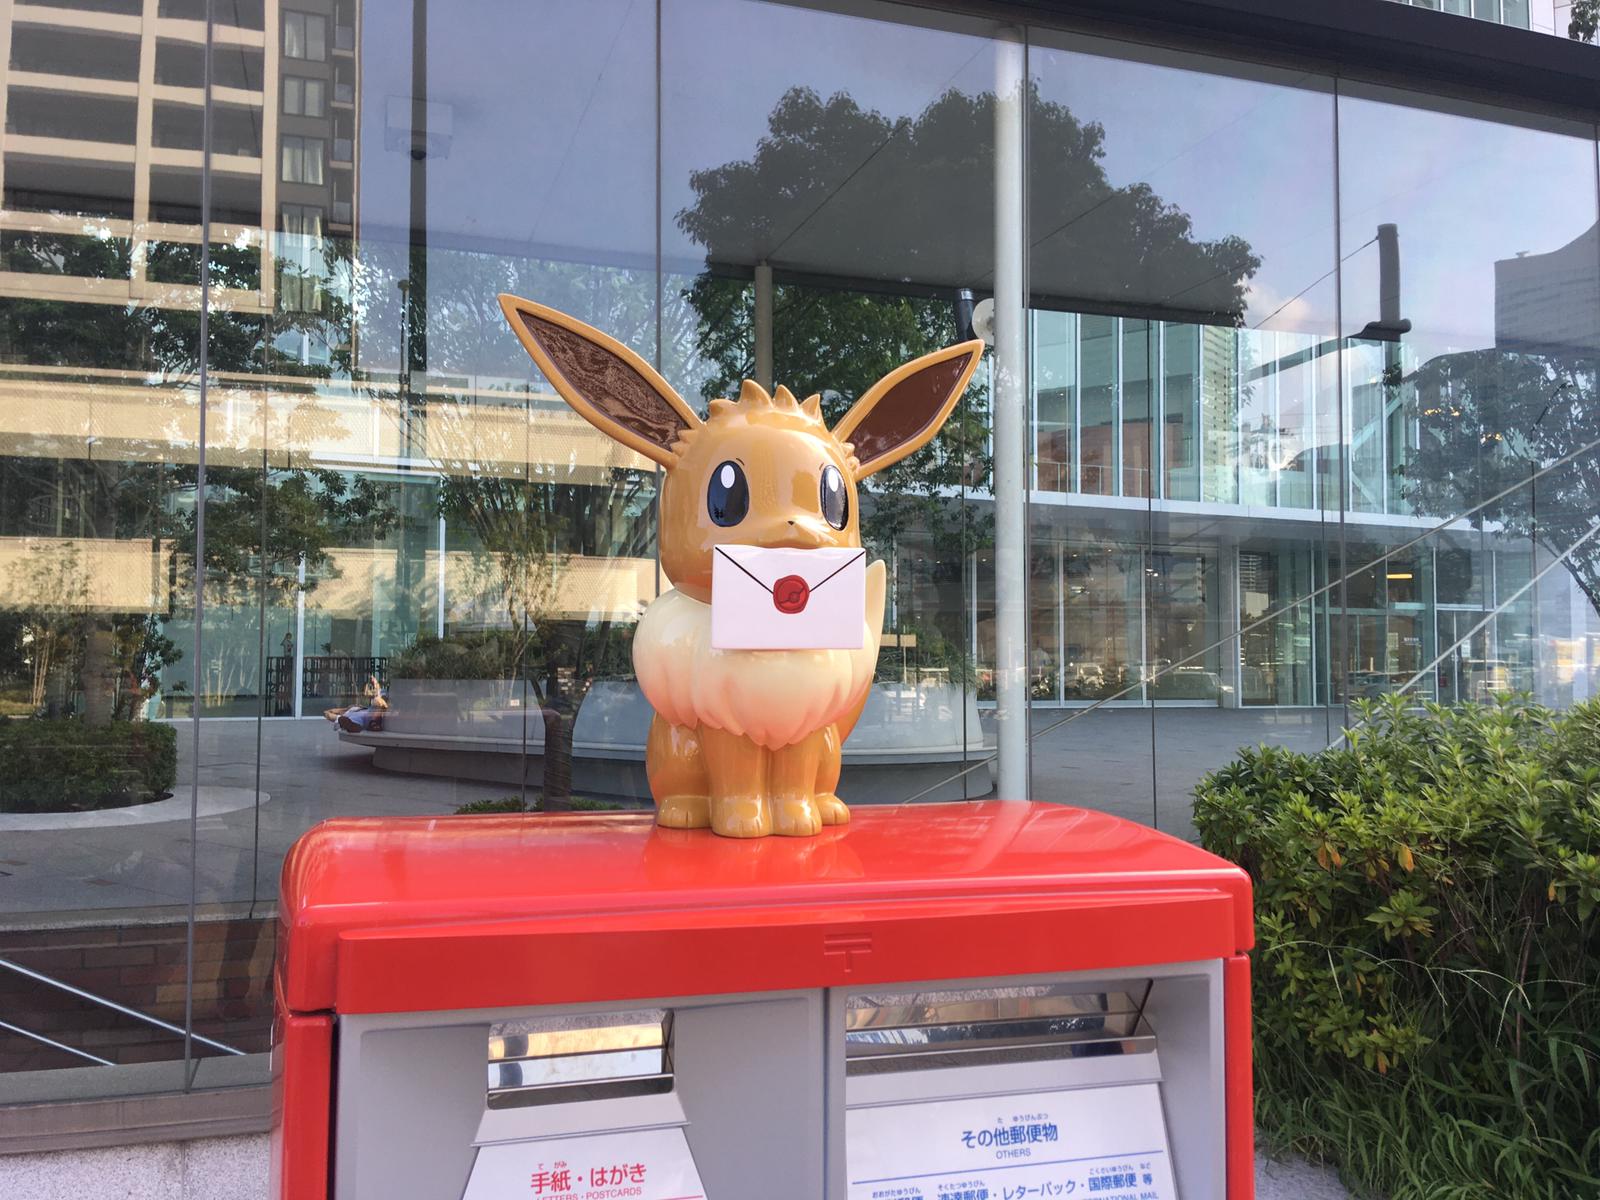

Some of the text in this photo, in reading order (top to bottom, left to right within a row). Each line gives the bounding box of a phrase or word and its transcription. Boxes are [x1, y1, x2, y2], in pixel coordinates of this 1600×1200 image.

[961, 1122, 1058, 1148] その他郵便物
[995, 1148, 1031, 1159] OTHERS
[530, 1163, 646, 1194] 手紙・はがき
[586, 1187, 642, 1200] POSTCARDS
